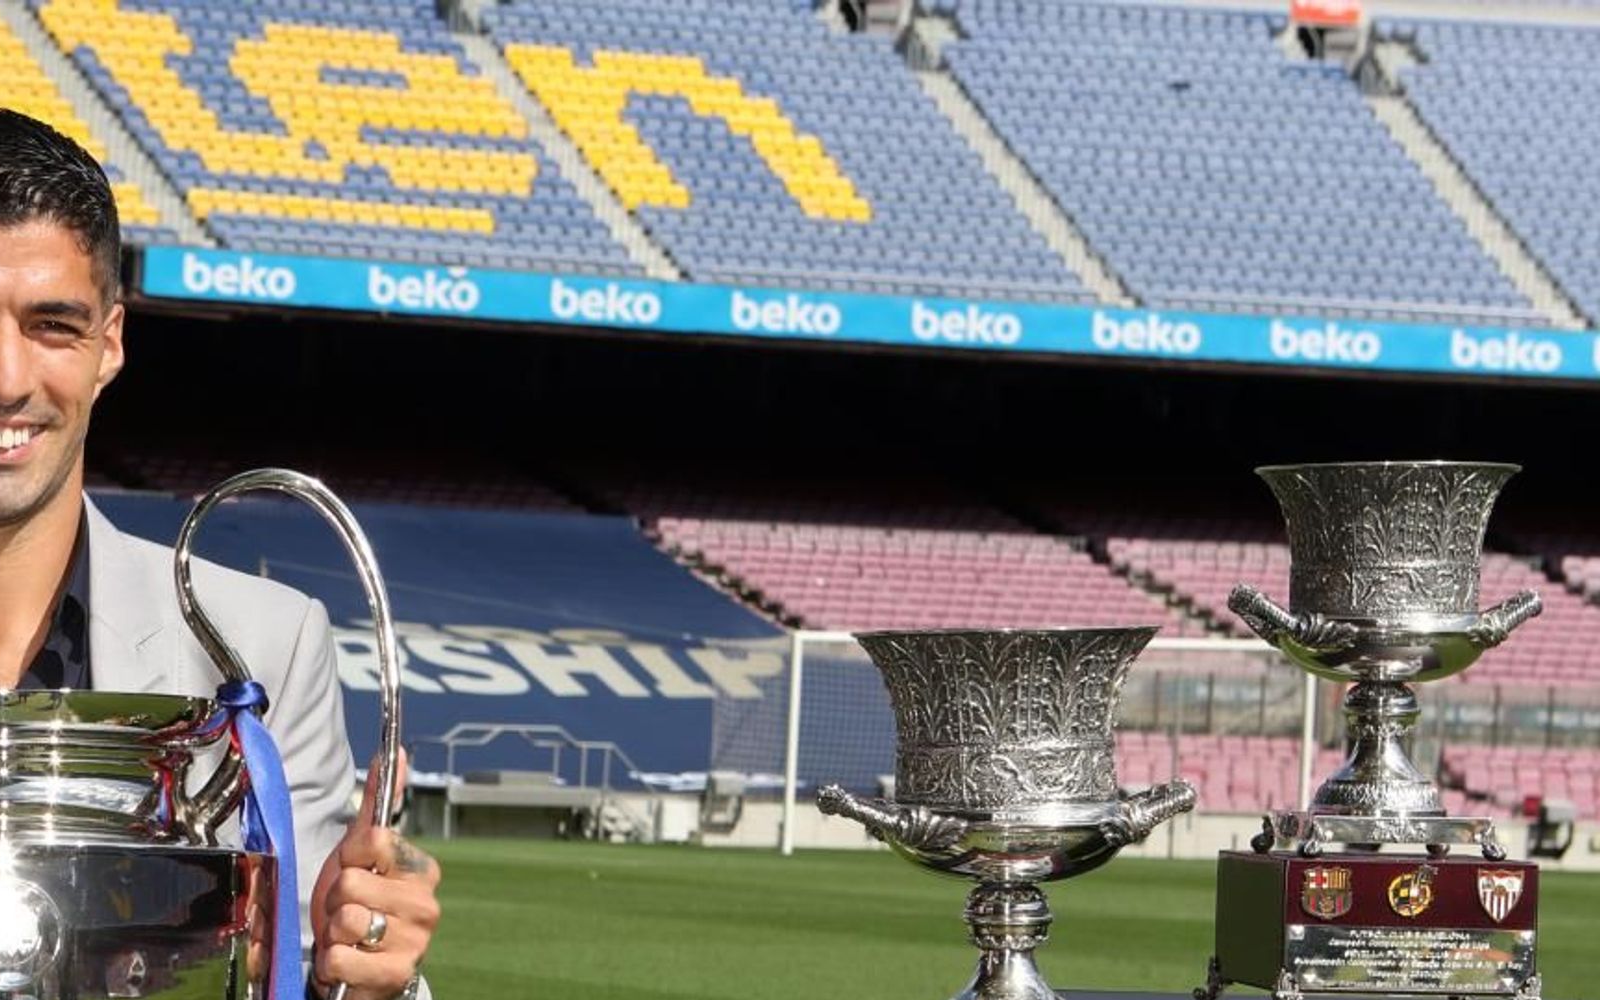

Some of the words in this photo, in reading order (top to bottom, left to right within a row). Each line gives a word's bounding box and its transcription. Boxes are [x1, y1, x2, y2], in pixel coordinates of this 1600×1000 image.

[183, 253, 296, 299] beko
[368, 265, 480, 312] beko
[551, 279, 661, 323] beko
[731, 291, 841, 335] beko
[911, 301, 1022, 344] beko
[1092, 310, 1202, 353] beko
[1270, 320, 1381, 363] beko
[1450, 330, 1563, 372] beko
